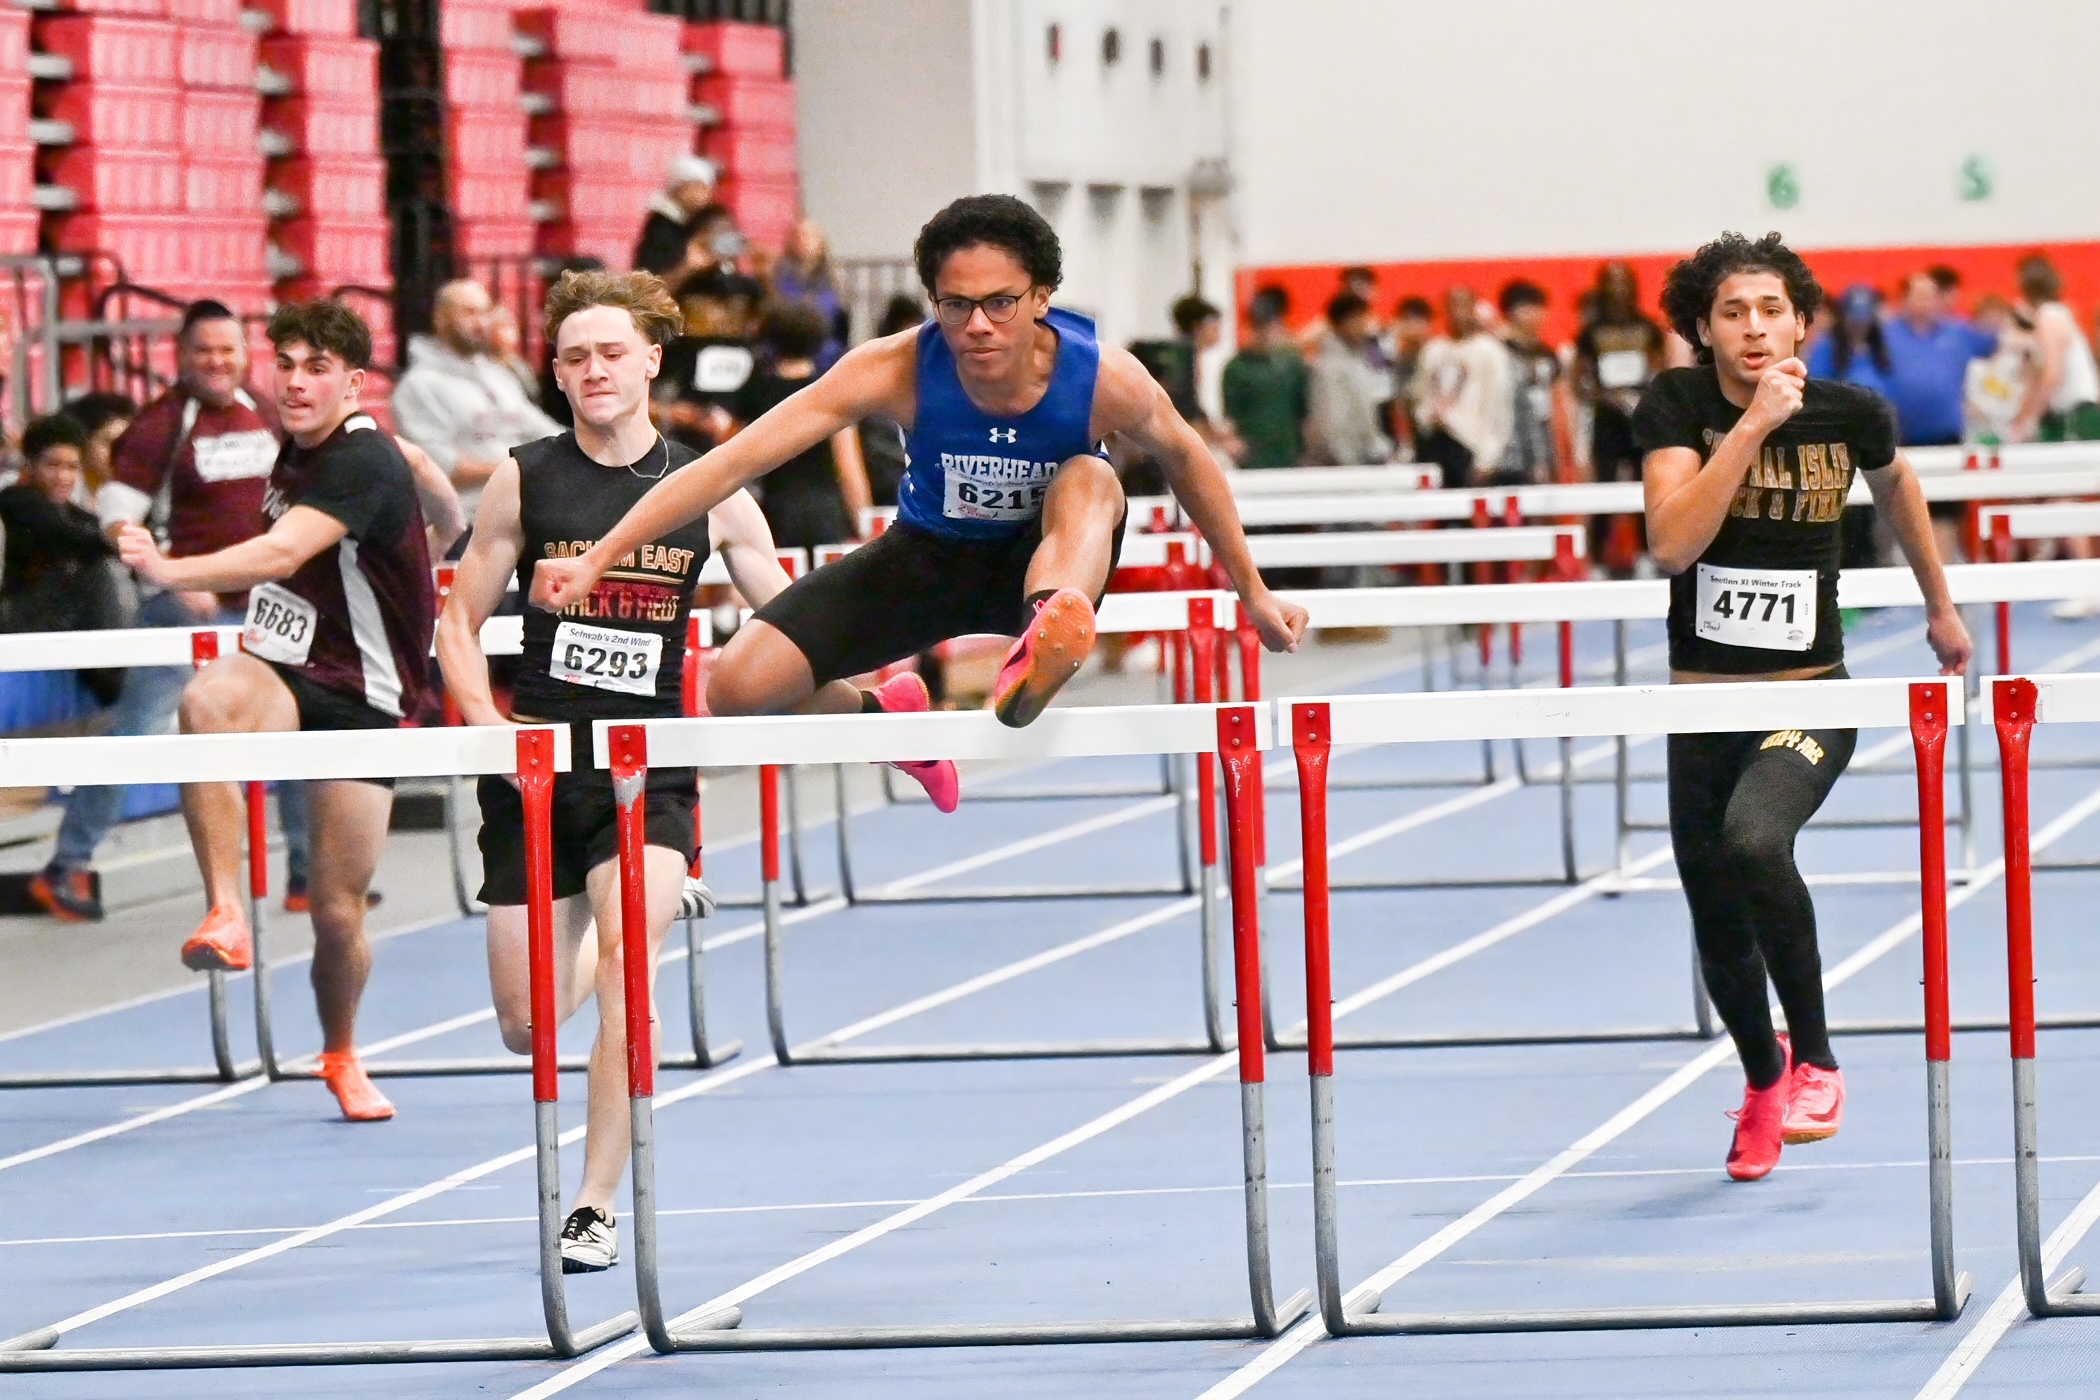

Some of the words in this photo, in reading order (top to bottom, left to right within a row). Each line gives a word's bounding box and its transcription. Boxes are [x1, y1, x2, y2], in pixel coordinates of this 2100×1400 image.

[641, 544, 695, 575] EAST
[1710, 574, 1738, 586] Section
[1751, 579, 1779, 589] Winter
[1781, 580, 1802, 588] Track
[253, 597, 309, 644] 6683
[1713, 590, 1796, 625] 4771
[569, 628, 611, 643] Schwab's
[610, 635, 630, 646] 2nd
[630, 637, 653, 648] Wind
[563, 643, 649, 680] 6293
